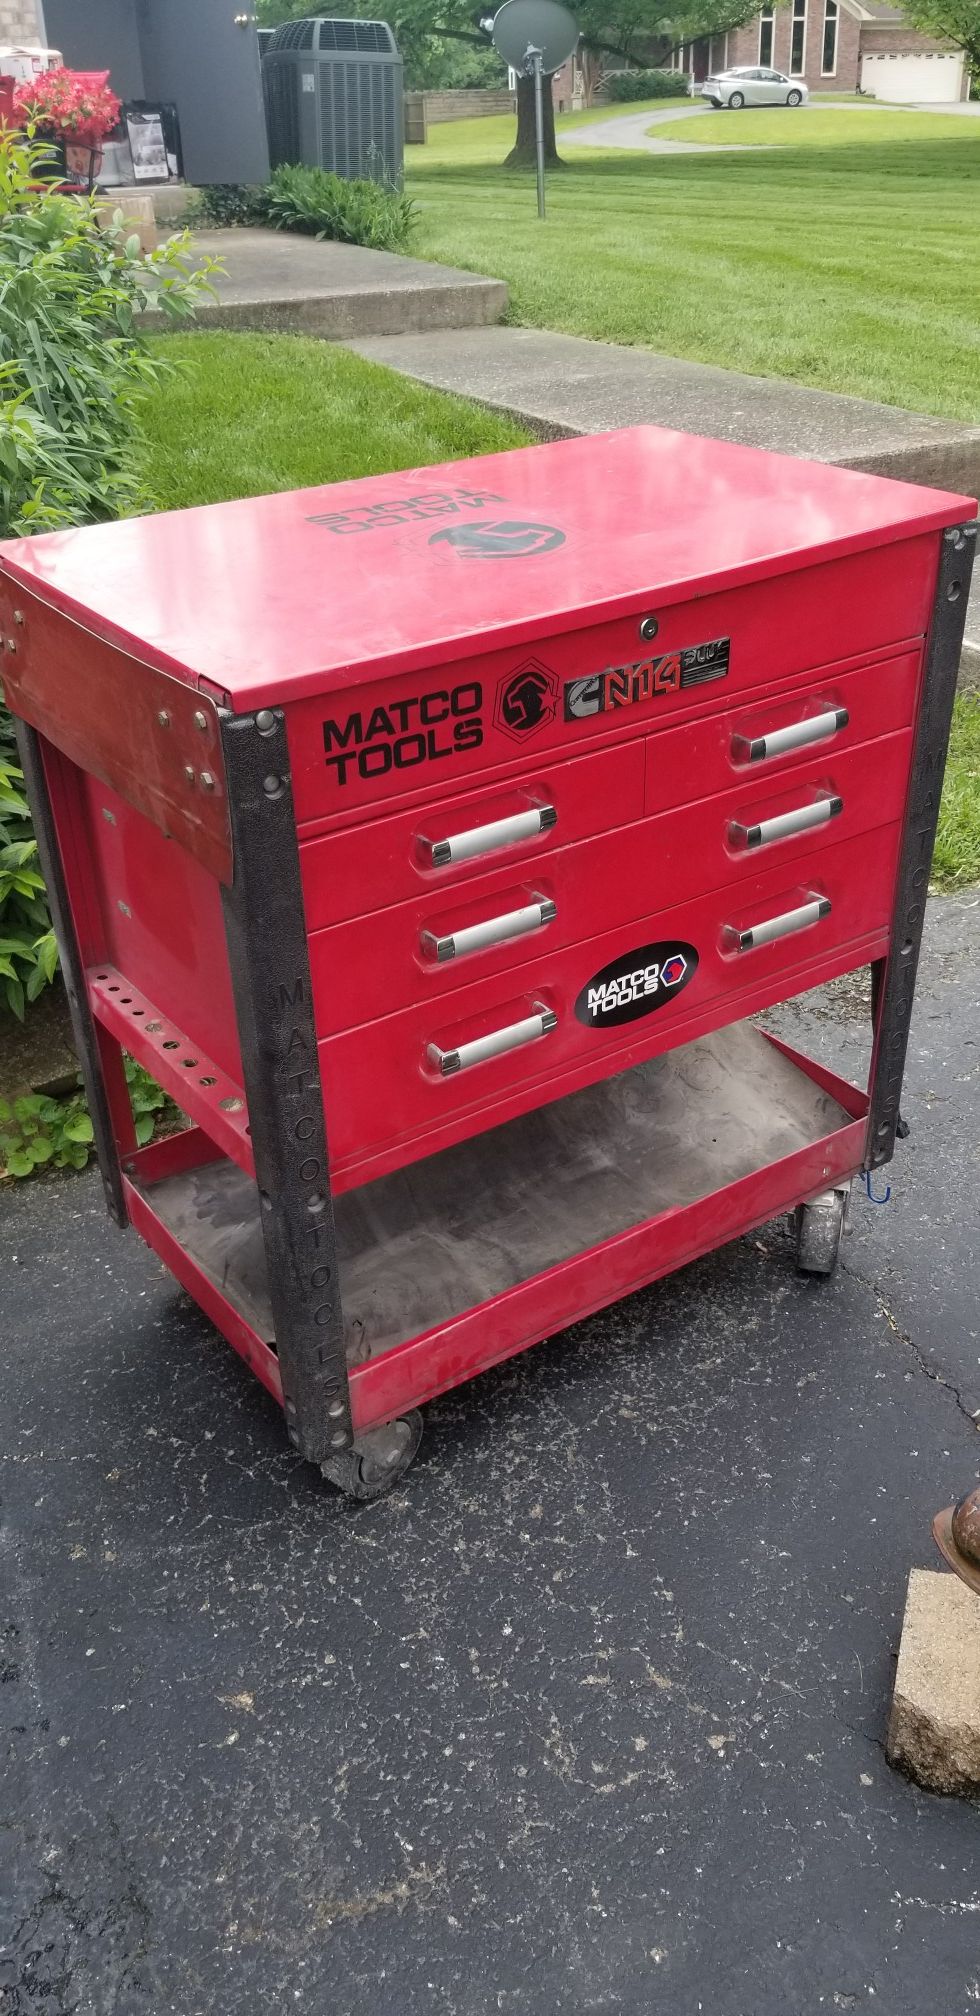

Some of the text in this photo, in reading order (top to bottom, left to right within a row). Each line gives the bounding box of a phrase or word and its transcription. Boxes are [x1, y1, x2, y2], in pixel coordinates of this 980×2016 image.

[305, 488, 487, 526] TOOLS
[327, 494, 511, 535] MATCO
[604, 655, 681, 711] N14
[322, 681, 483, 753] MATCO
[326, 717, 484, 786] TOOLS
[587, 978, 659, 1017] TOOLS
[588, 963, 660, 1004] MATCO
[278, 976, 321, 1182] MATCO
